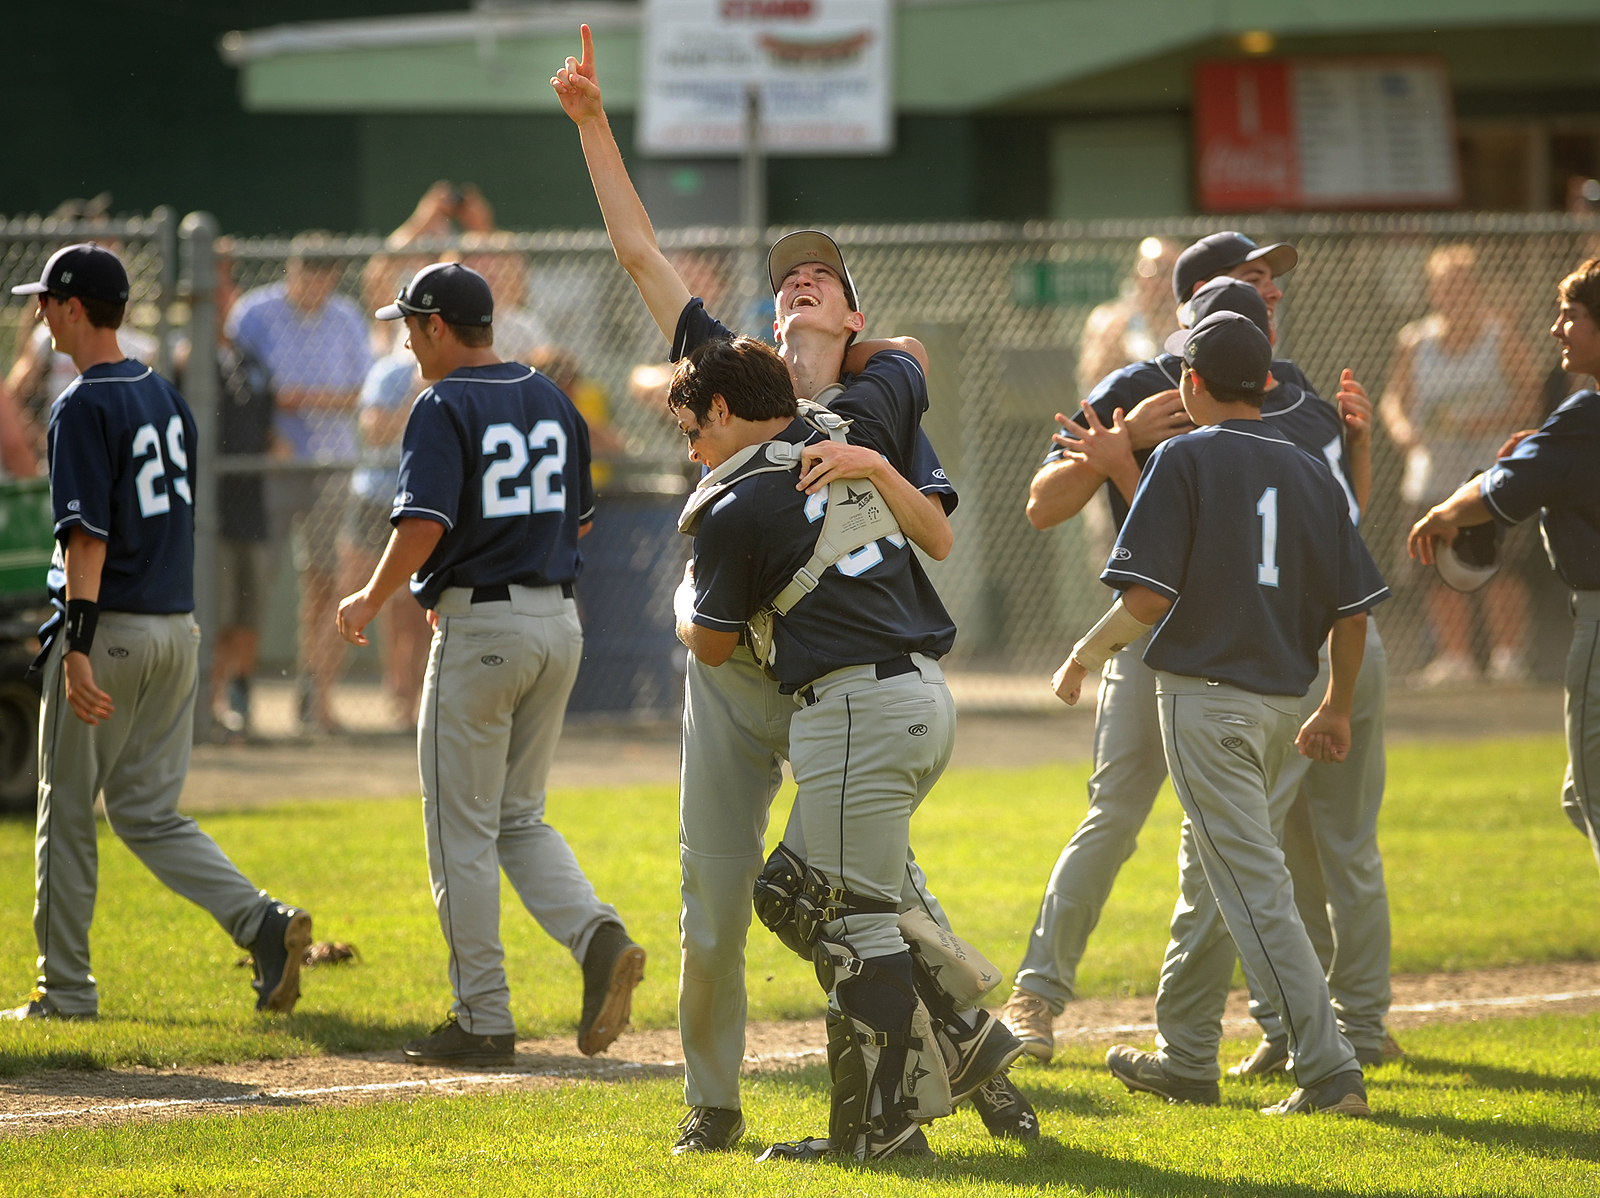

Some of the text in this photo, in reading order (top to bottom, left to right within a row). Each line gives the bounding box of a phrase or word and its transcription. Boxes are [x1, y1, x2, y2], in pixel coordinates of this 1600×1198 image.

[132, 414, 193, 519] 29
[481, 419, 568, 519] 22
[1256, 486, 1280, 588] 1
